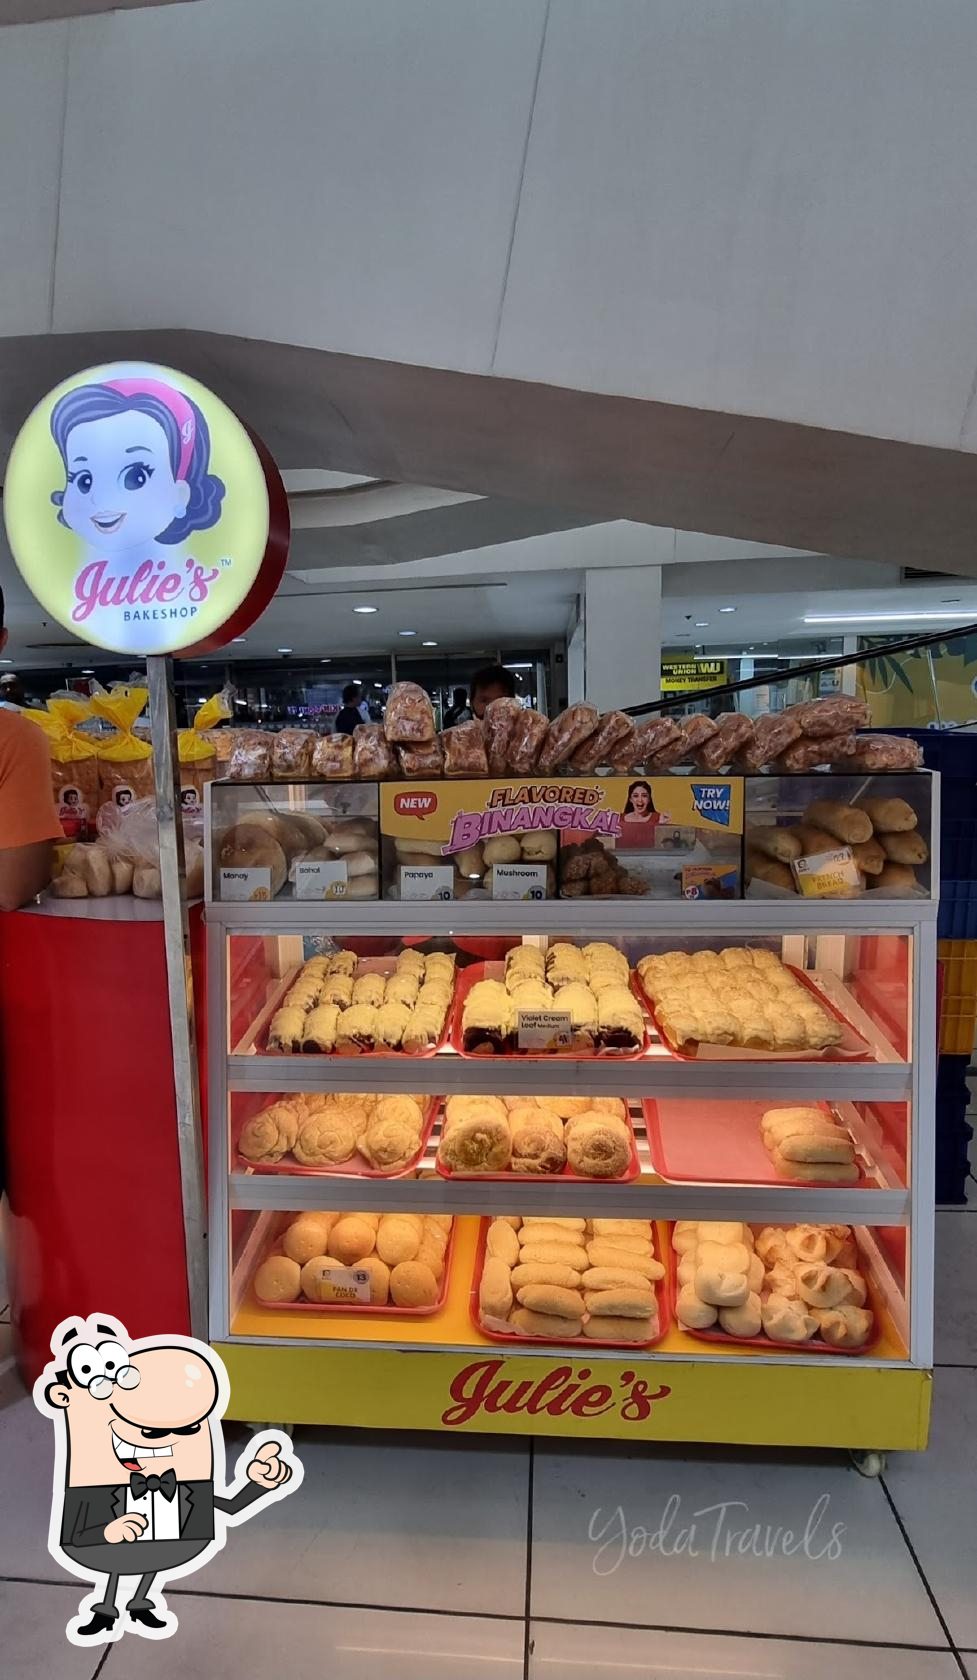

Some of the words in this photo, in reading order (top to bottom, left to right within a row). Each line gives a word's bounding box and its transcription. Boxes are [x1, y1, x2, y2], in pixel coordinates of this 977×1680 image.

[72, 558, 219, 622] Julie's
[221, 558, 232, 566] TM
[124, 606, 198, 621] BAKESHOP
[490, 786, 600, 808] FLAVORED
[700, 788, 725, 799] TRY
[400, 797, 432, 809] NEW
[694, 800, 730, 810] NOW!
[443, 806, 622, 855] BINANGKAL
[404, 871, 434, 880] Papaya
[497, 869, 538, 878] Mushroom
[439, 891, 451, 900] 10
[530, 889, 543, 900] 10
[521, 1021, 537, 1029] Loaf
[441, 1359, 672, 1426] Julie's
